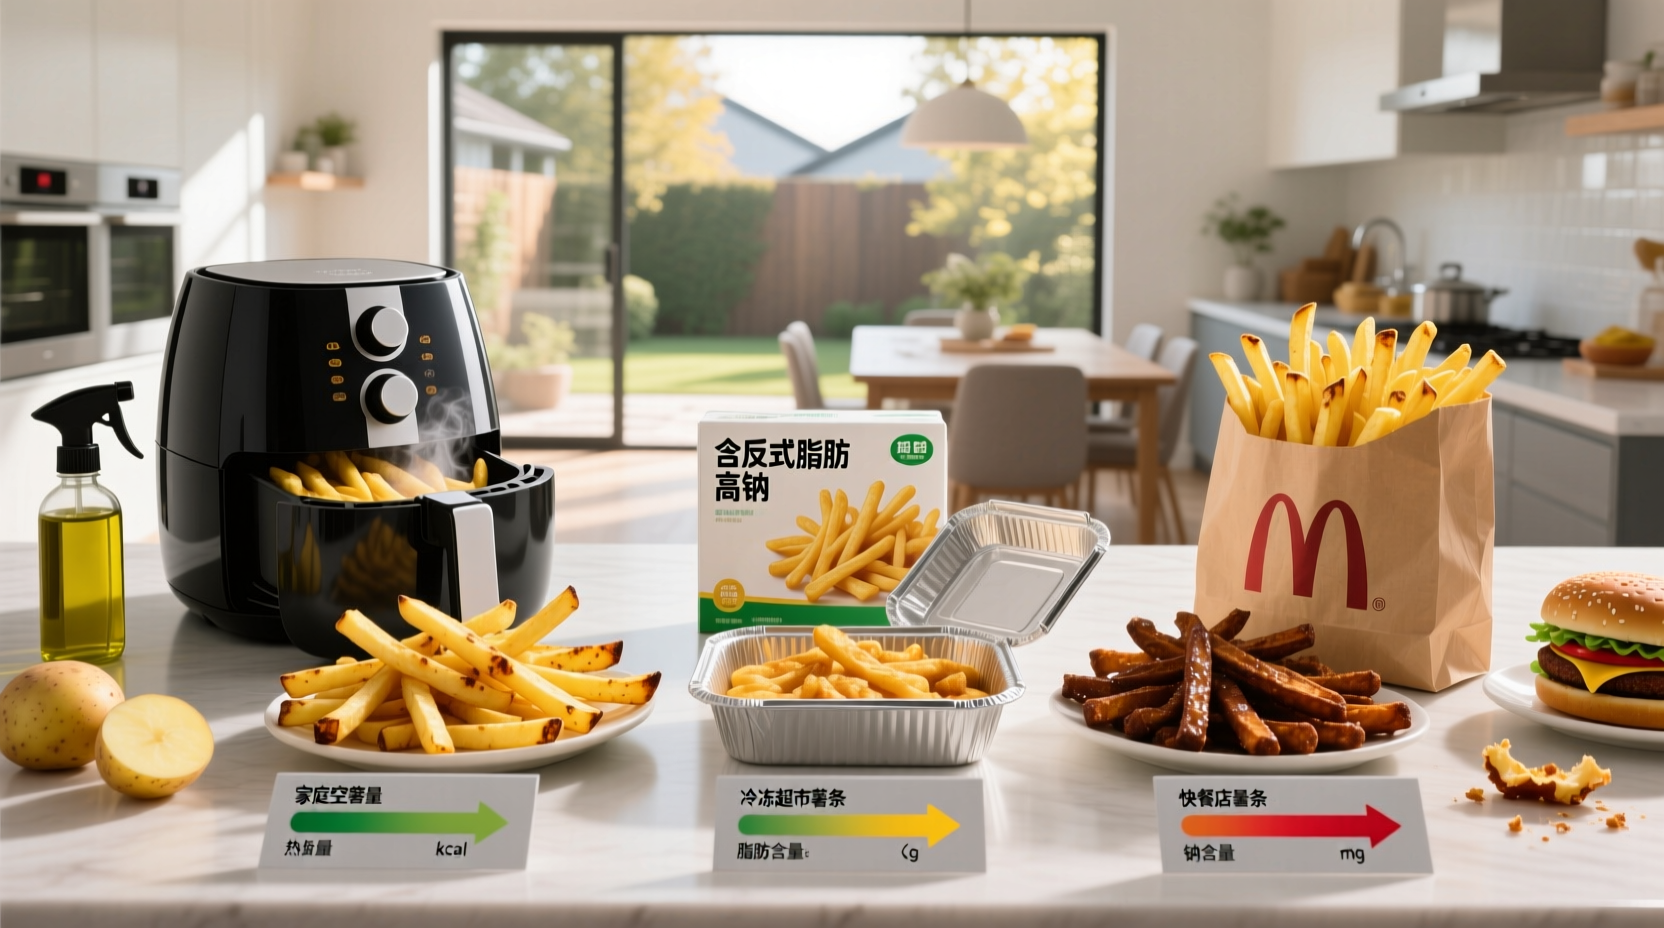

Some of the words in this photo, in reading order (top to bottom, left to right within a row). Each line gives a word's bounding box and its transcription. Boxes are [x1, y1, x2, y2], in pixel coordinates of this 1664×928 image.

[715, 437, 850, 470] 含反式脂肪
[715, 471, 769, 502] 高钠
[741, 788, 846, 808] 冷冻超市薯条
[436, 841, 467, 857] kcal
[1340, 848, 1365, 864] mg
